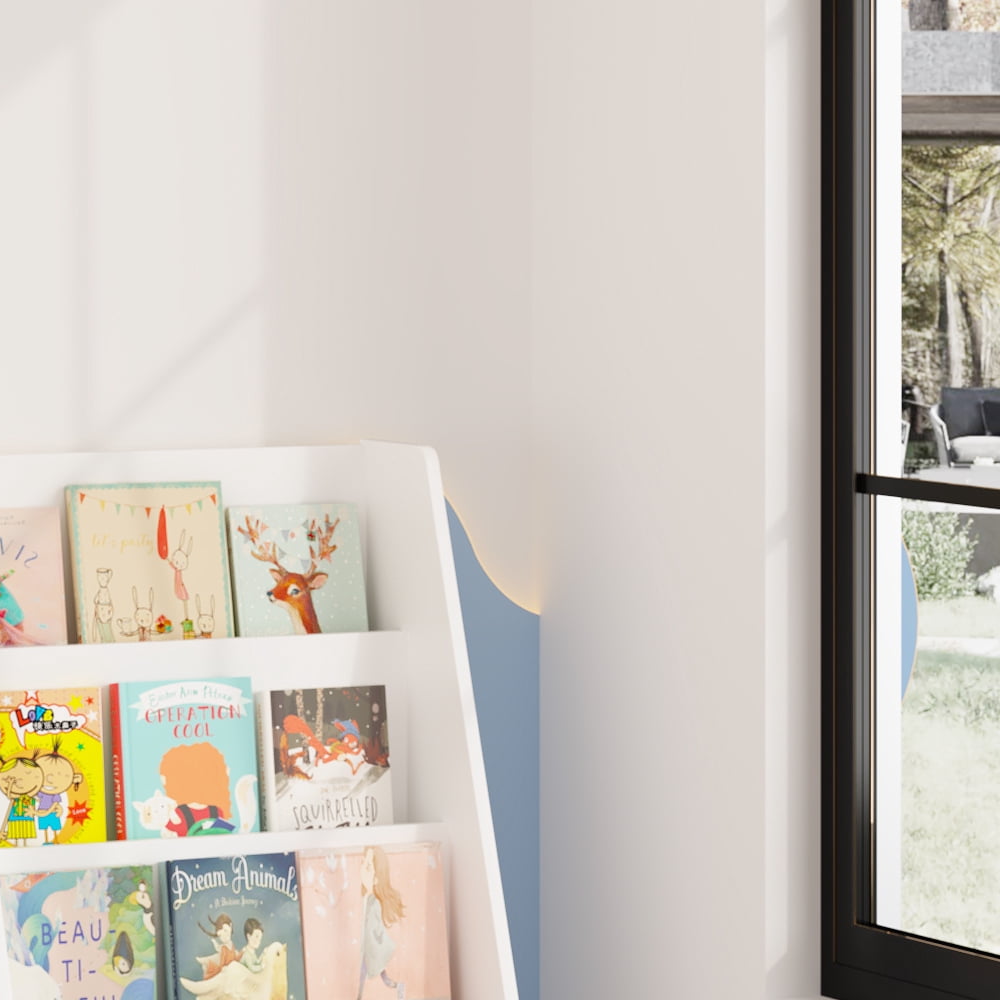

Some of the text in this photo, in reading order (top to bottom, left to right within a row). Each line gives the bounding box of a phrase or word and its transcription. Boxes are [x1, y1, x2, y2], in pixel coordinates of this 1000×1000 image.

[15, 705, 54, 728] Love
[145, 704, 240, 723] OPERATION
[173, 722, 214, 738] COOL
[293, 795, 379, 830] SQUIRRELLED
[171, 855, 298, 911] Dream Animals
[41, 919, 116, 946] BEAU-
[61, 959, 96, 983] TI-
